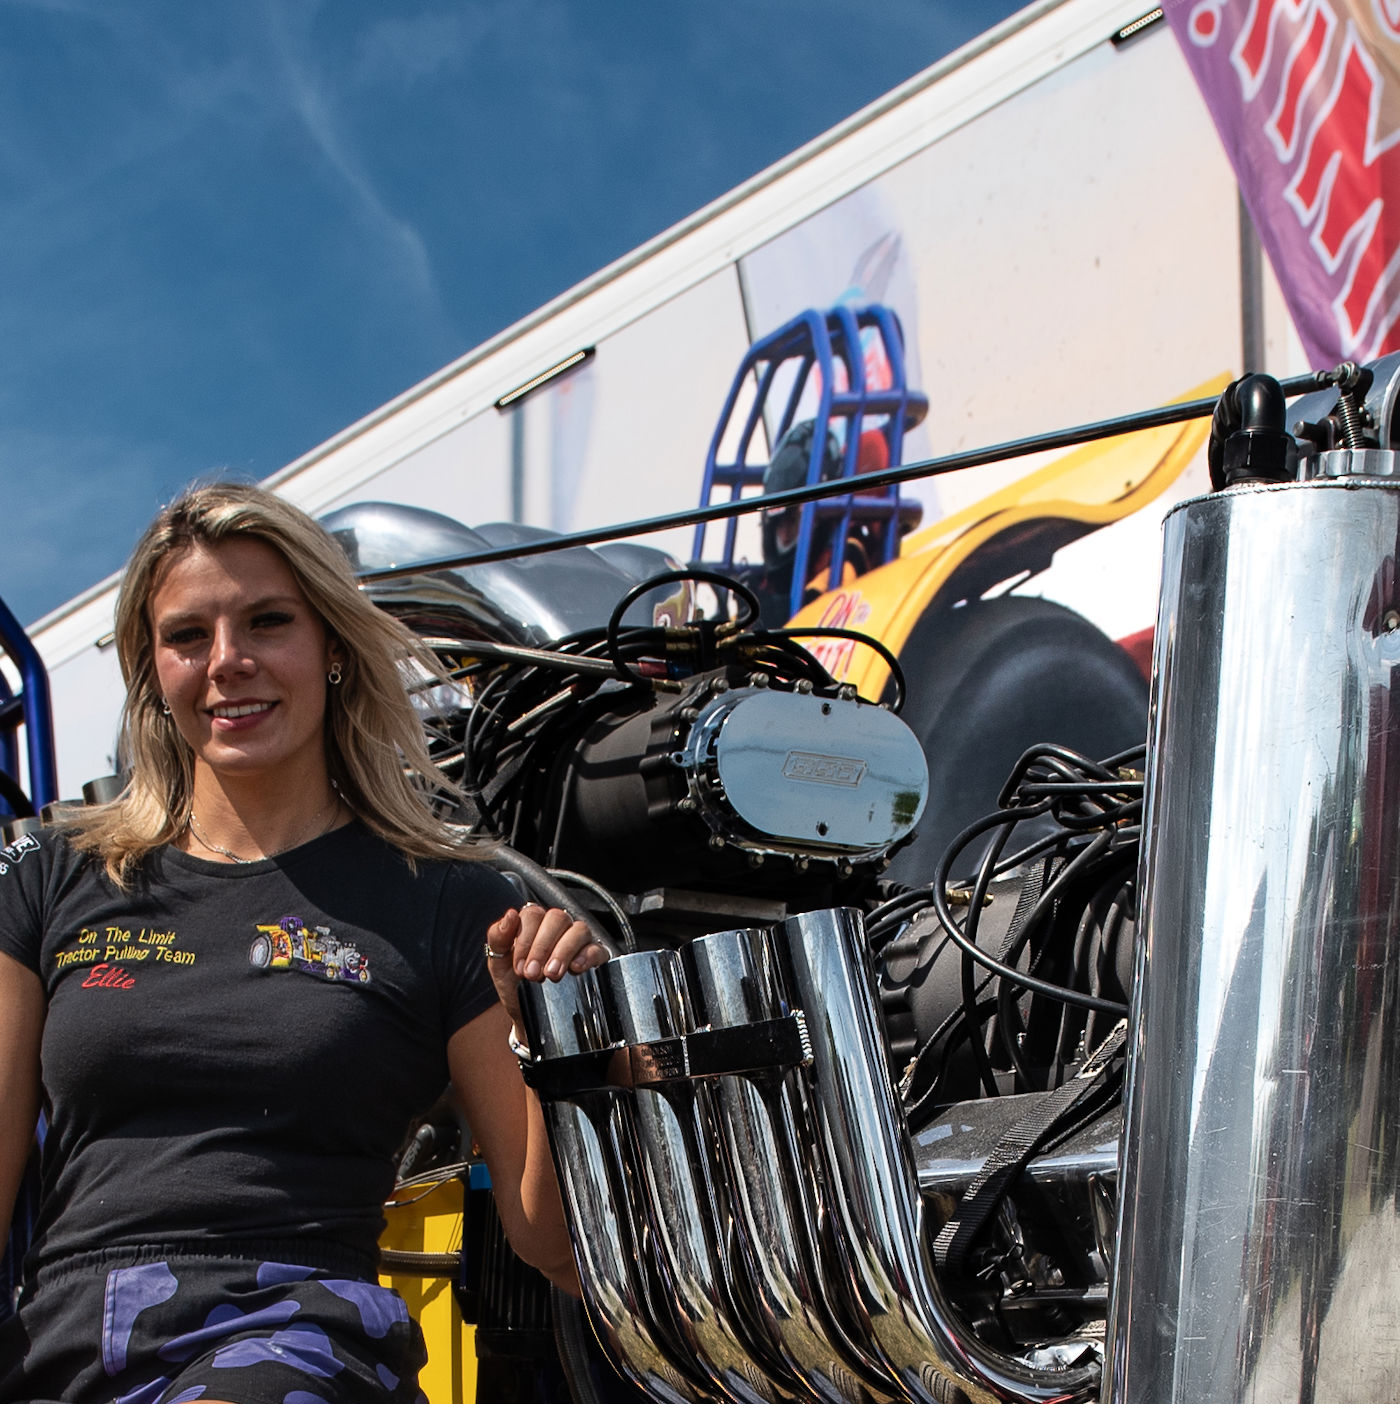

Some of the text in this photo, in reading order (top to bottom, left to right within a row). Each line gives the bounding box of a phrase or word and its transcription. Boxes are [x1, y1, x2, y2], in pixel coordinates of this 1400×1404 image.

[78, 926, 176, 945] On The Limit
[55, 945, 196, 969] Tractor Pulling Team
[81, 963, 136, 990] Ellie
